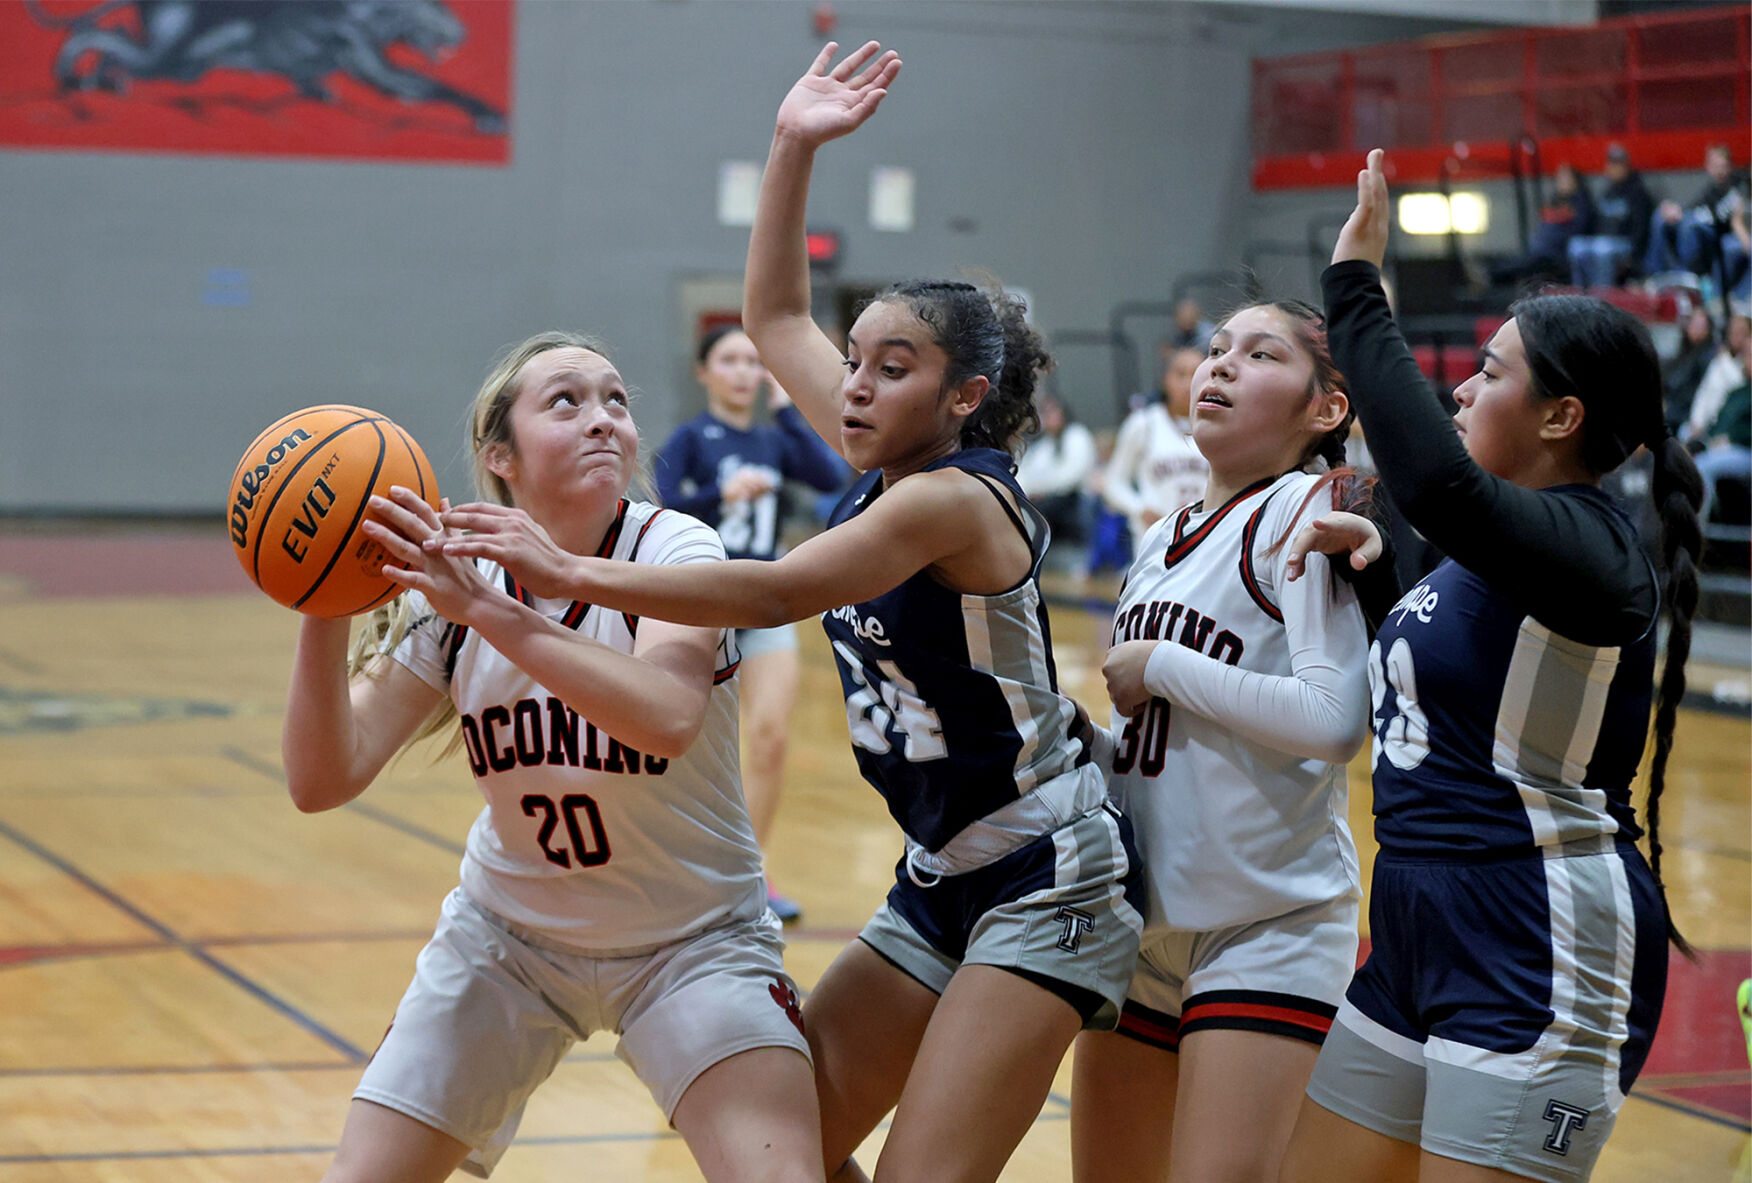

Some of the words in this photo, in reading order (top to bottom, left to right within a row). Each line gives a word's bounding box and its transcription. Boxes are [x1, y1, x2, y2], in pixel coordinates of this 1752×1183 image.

[231, 427, 313, 549] Wilson
[320, 452, 341, 479] NXT
[832, 639, 949, 763] 24
[1111, 694, 1172, 778] 30
[520, 793, 612, 870] 20
[1053, 904, 1096, 955] T
[1542, 1098, 1591, 1157] T
